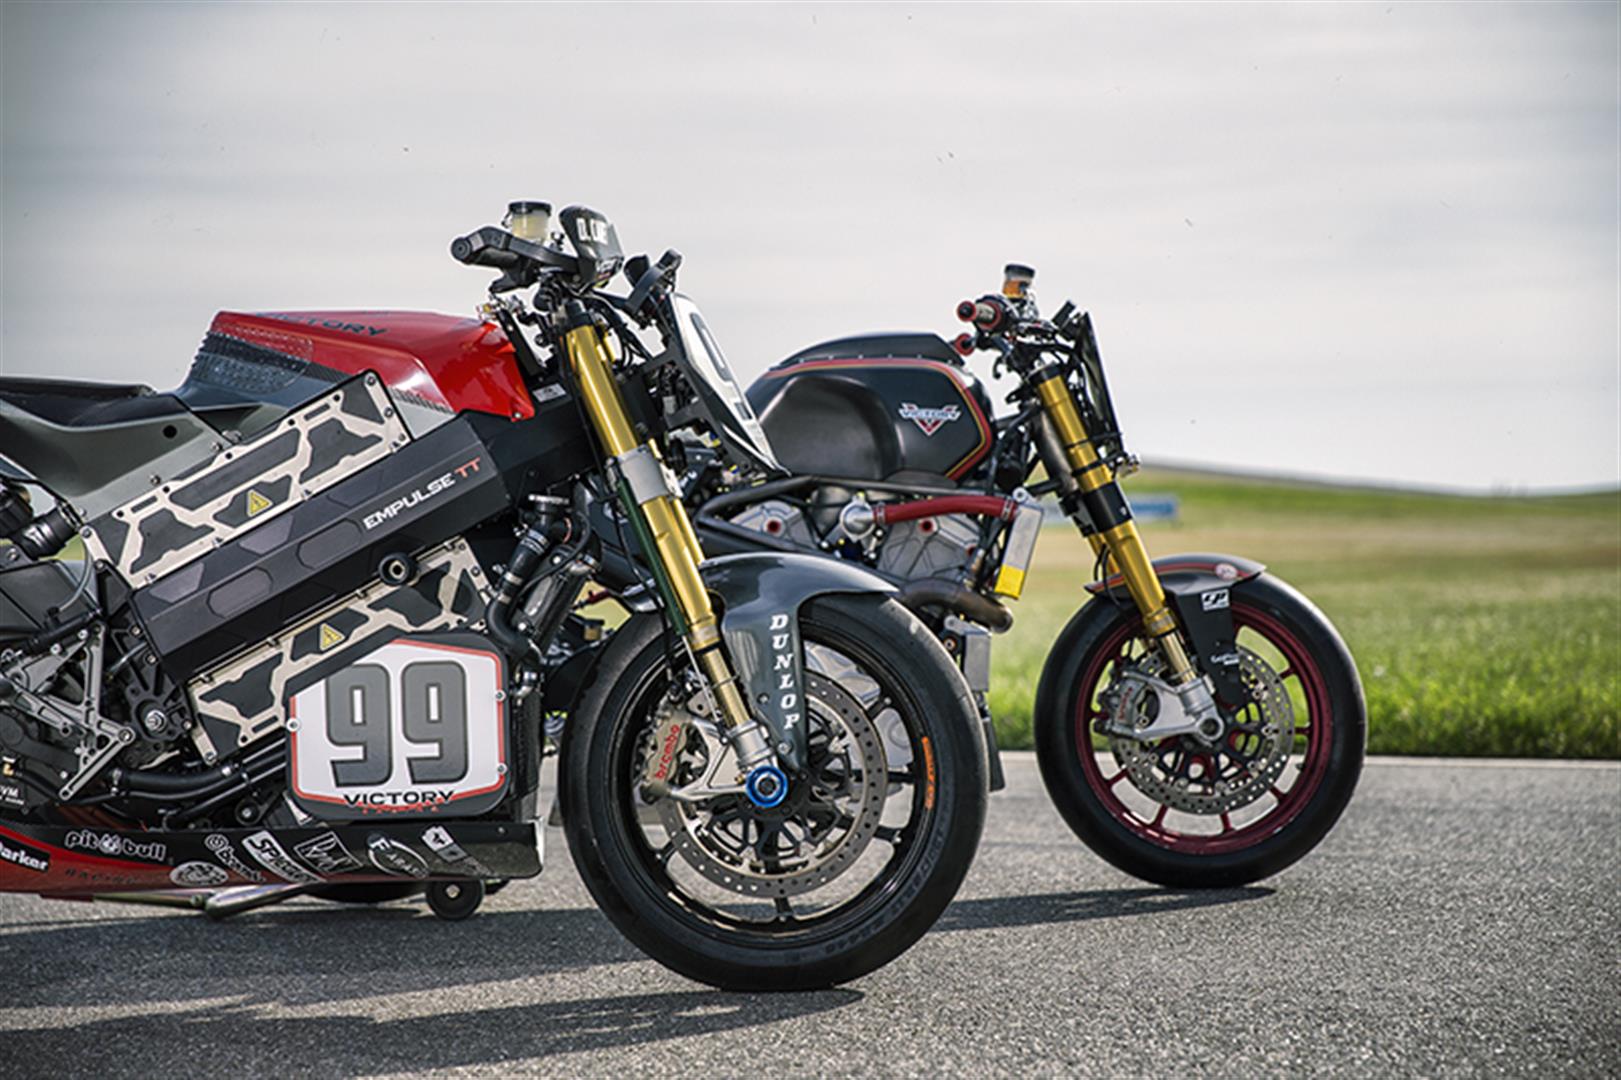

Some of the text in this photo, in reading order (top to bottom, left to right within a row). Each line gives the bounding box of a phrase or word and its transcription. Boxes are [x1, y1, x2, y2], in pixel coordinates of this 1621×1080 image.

[363, 456, 481, 530] EMPULSE TT
[769, 614, 800, 730] DUNLOP
[325, 660, 468, 788] 99
[655, 724, 680, 779] brembo
[343, 789, 455, 805] VICTORY
[64, 829, 167, 862] pit bull
